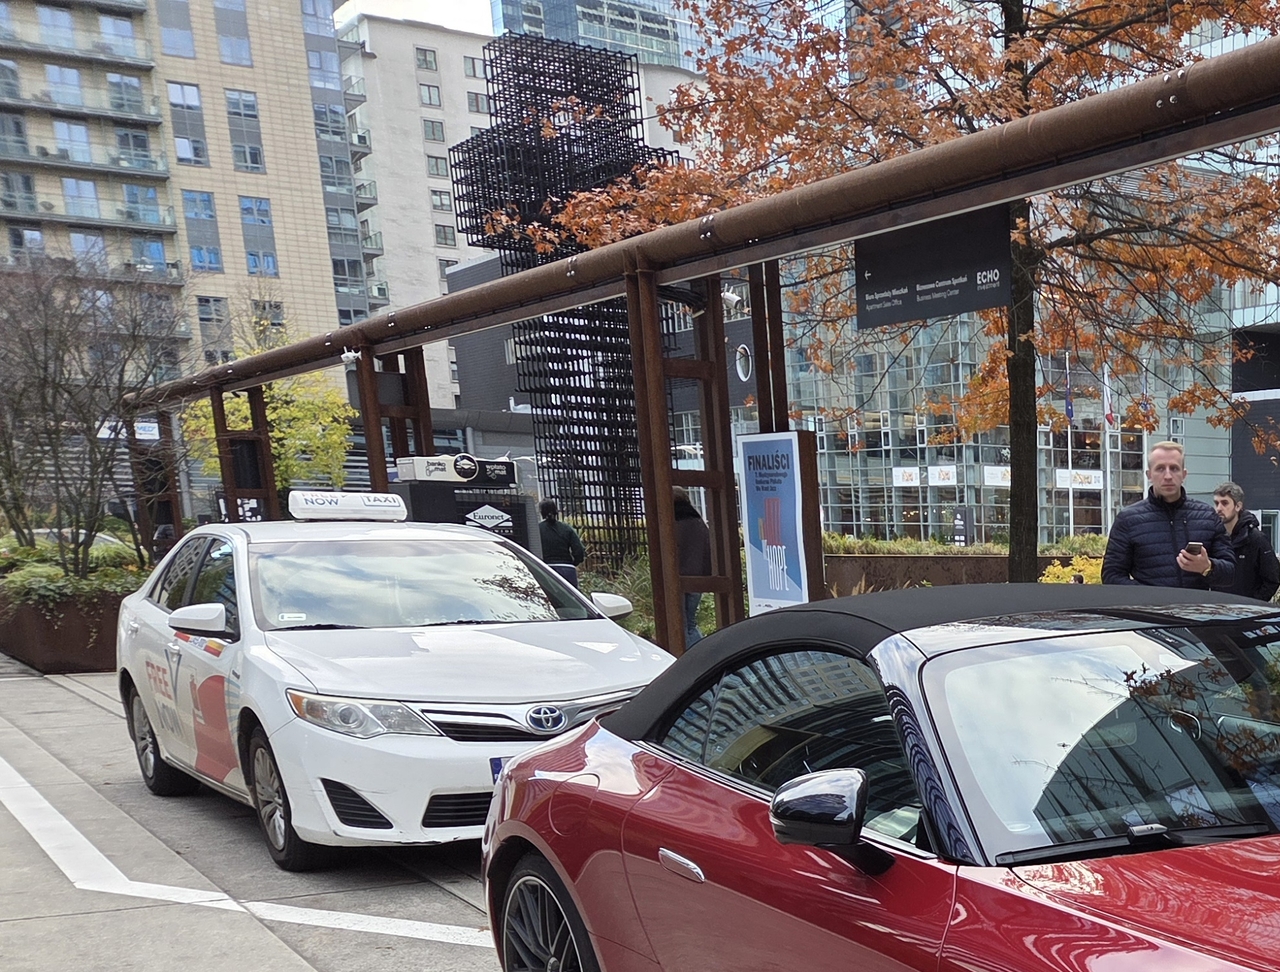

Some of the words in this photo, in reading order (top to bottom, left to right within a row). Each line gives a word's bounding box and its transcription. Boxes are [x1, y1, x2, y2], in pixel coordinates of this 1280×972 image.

[977, 269, 1000, 285] ECHO
[747, 449, 790, 471] FINALIŚCI
[304, 498, 338, 506] NOW
[364, 495, 398, 504] TAXI
[473, 511, 504, 521] Euronet
[145, 660, 173, 701] FREE
